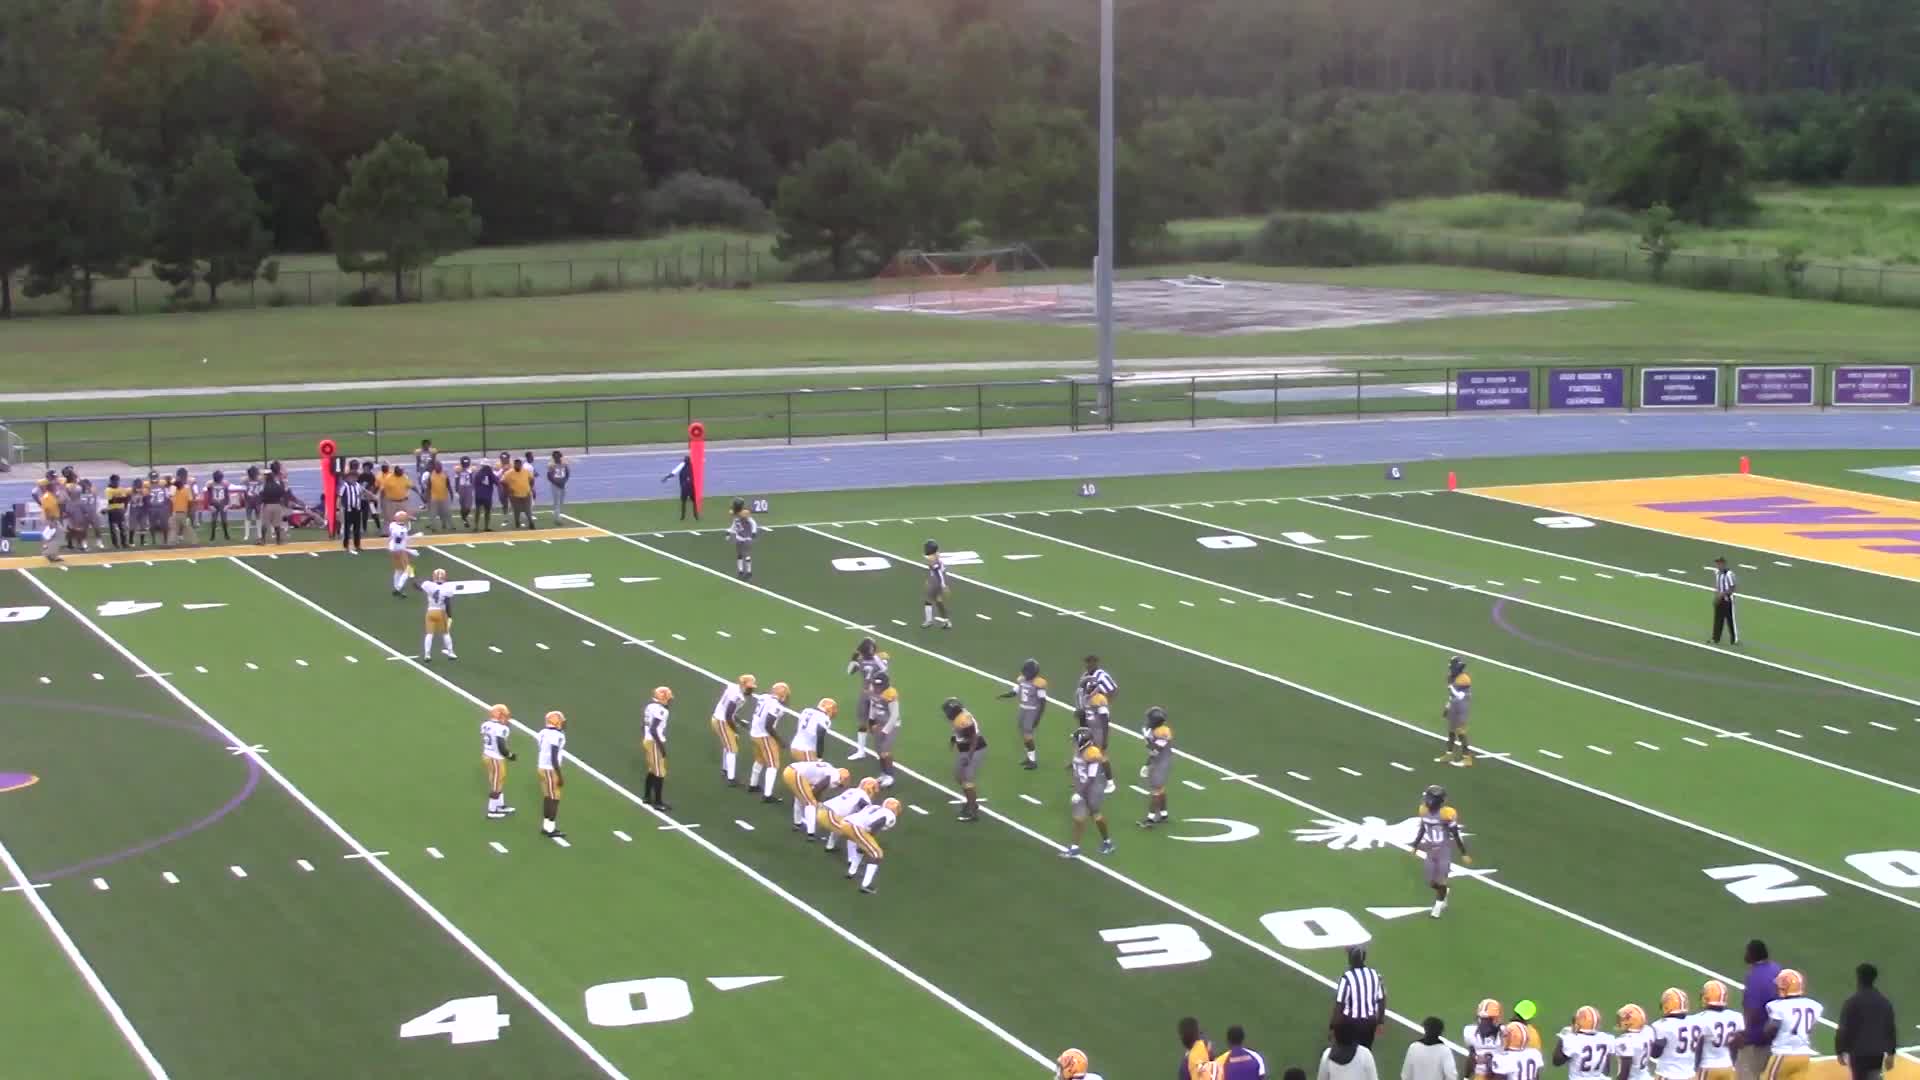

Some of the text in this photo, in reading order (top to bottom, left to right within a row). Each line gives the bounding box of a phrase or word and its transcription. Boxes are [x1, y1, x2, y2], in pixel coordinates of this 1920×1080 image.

[1082, 483, 1096, 496] 10
[753, 499, 768, 512] 20
[432, 589, 441, 605] 4
[1791, 1007, 1815, 1036] 70
[1676, 1025, 1705, 1054] 58
[1517, 1058, 1537, 1080] 10
[1580, 1044, 1608, 1072] 27
